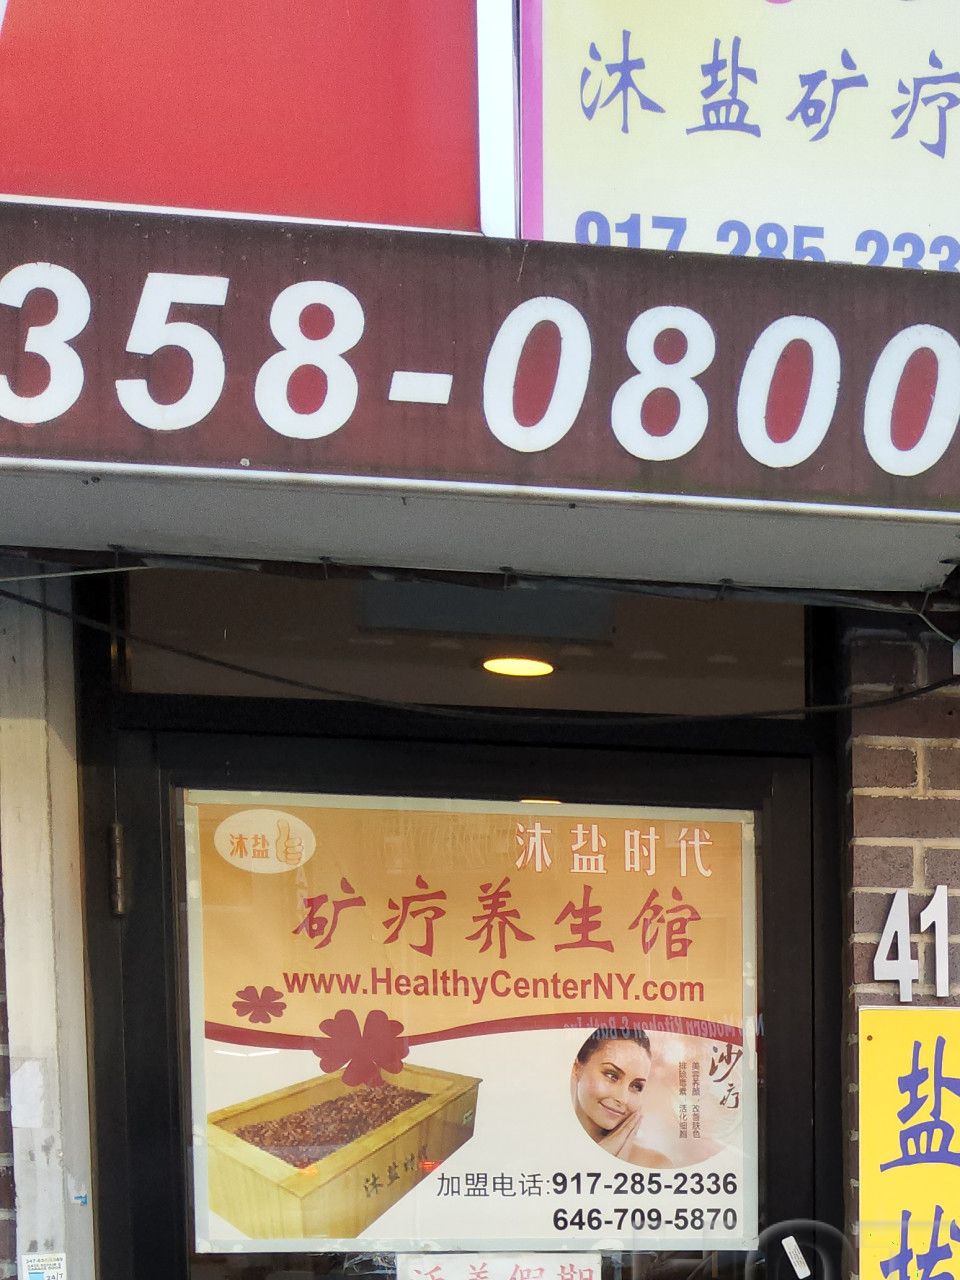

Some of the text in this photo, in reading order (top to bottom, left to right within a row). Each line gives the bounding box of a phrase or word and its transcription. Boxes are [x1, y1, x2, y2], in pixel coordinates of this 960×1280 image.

[515, 821, 714, 878] 沐盐时代
[292, 874, 702, 960] 矿疗养生馆
[283, 966, 705, 1004] www.HealthyCenterNY.com
[553, 1207, 738, 1233] 646-709-5870
